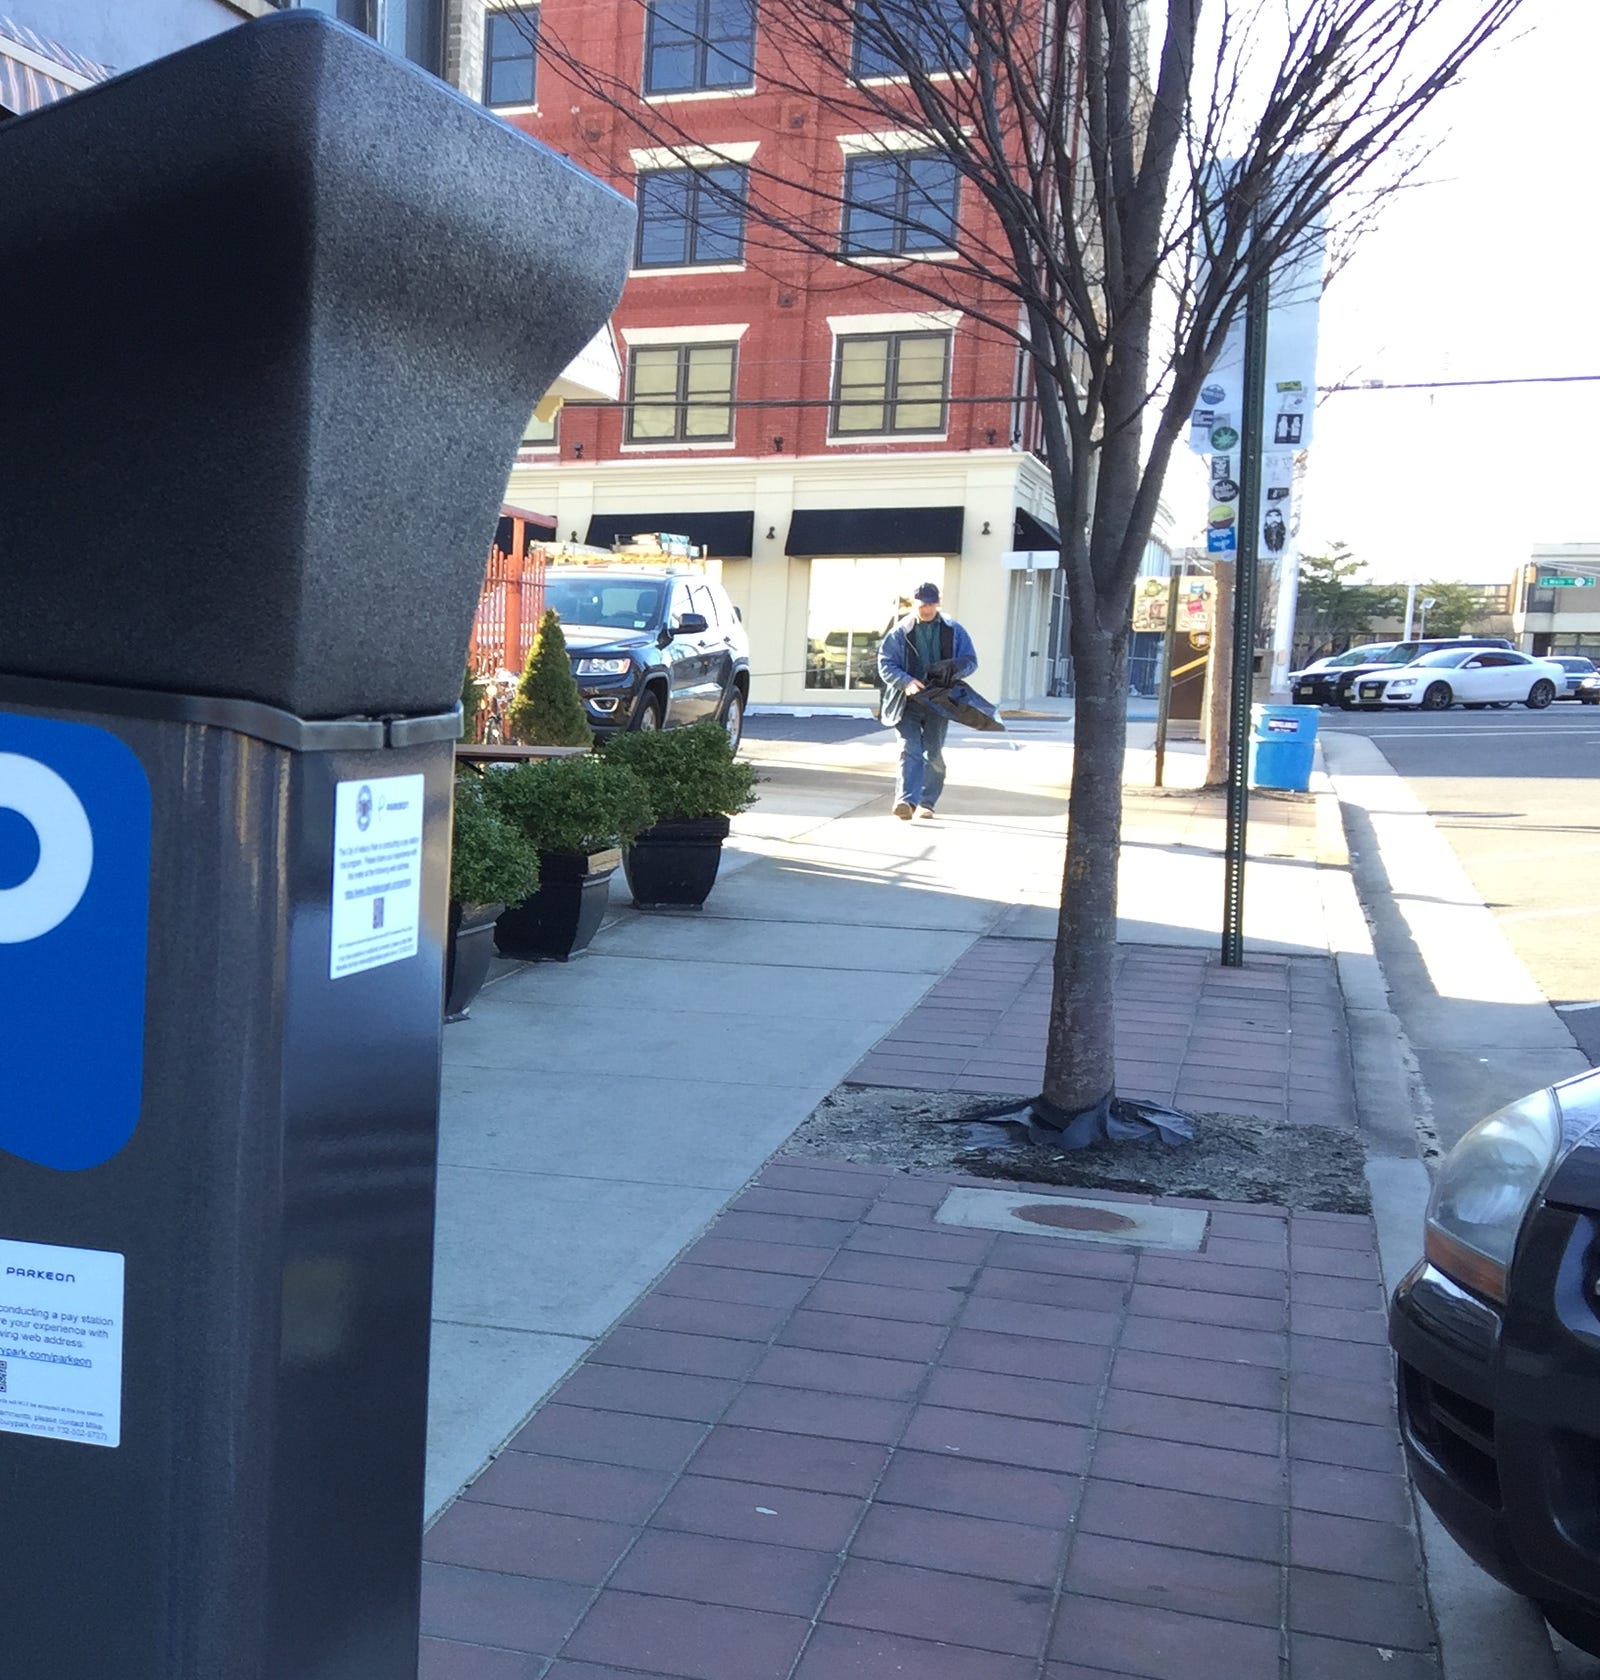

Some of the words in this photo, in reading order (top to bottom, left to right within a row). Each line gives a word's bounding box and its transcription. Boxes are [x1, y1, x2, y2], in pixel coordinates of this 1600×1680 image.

[6, 1266, 76, 1283] PARKEON
[52, 1311, 58, 1320] a
[60, 1313, 79, 1324] pay
[81, 1315, 114, 1327] station
[9, 1318, 32, 1329] your
[32, 1322, 87, 1336] experience
[88, 1328, 109, 1340] with
[21, 1331, 42, 1343] web
